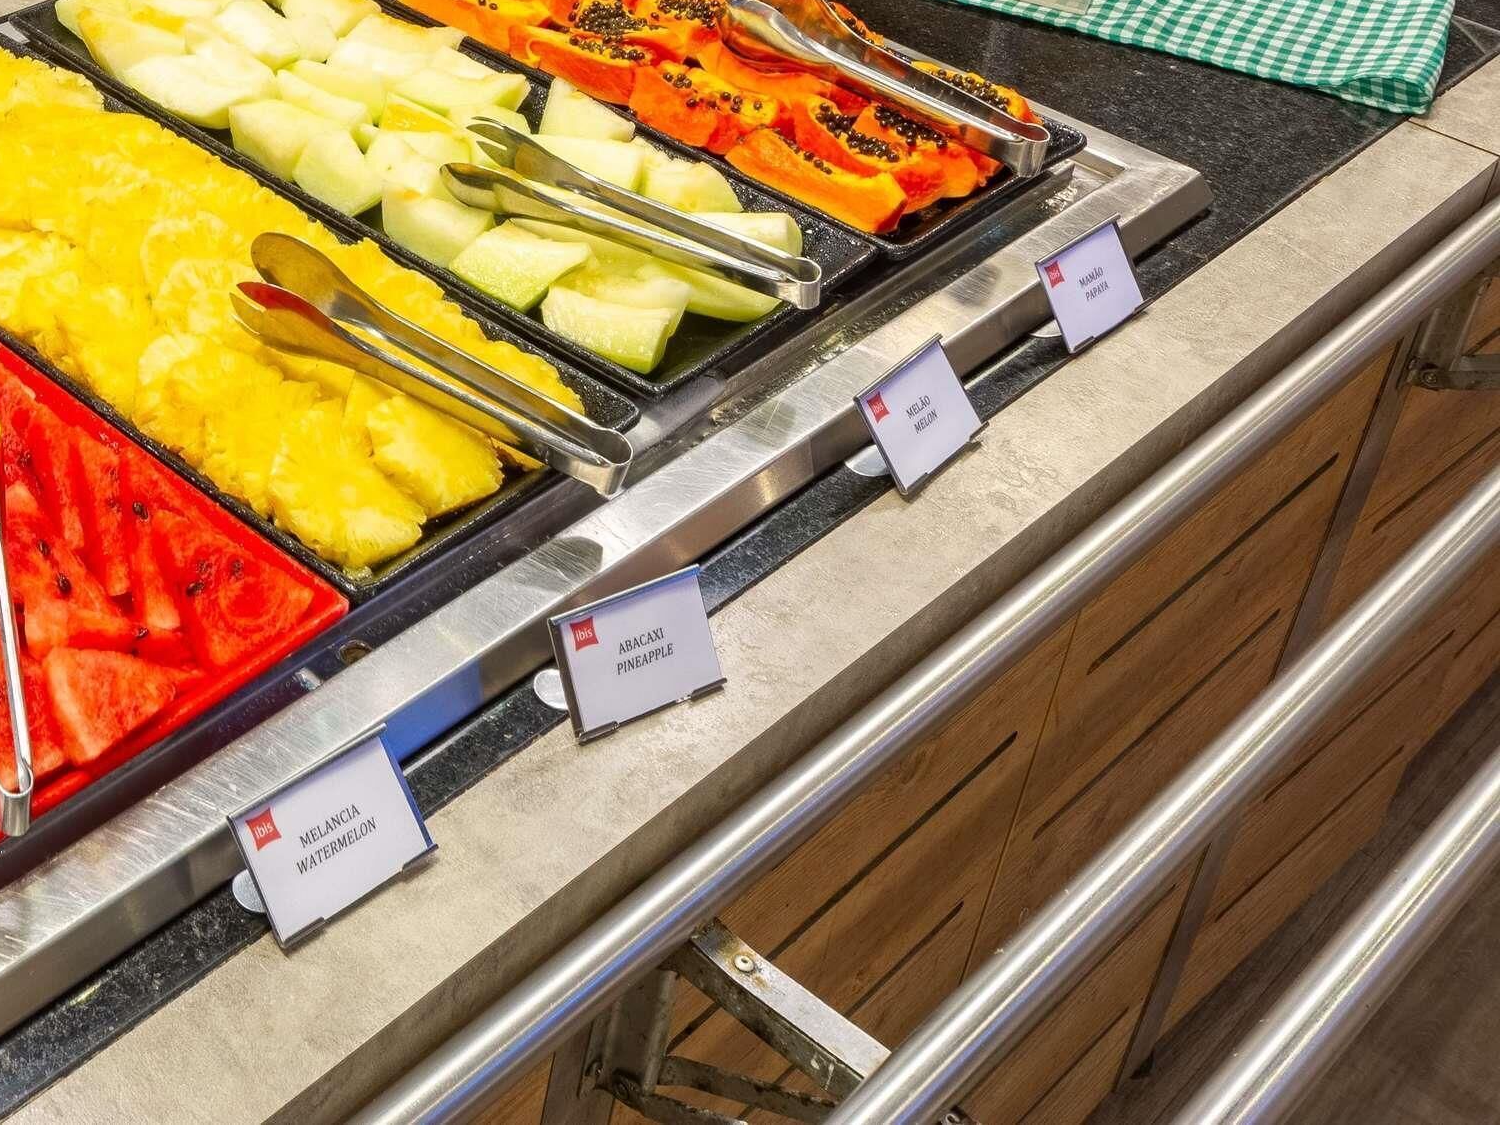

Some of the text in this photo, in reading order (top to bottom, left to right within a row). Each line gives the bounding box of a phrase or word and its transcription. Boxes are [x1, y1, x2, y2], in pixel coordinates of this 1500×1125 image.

[1085, 281, 1109, 301] PAPAYA
[914, 410, 938, 434] MELON
[575, 625, 593, 642] ibis
[619, 627, 664, 655] ABACAXI
[617, 643, 673, 675] PINEAPPLE
[253, 819, 274, 839] ibis
[300, 804, 361, 848] MELANCIA
[296, 817, 377, 875] WATERMELON
